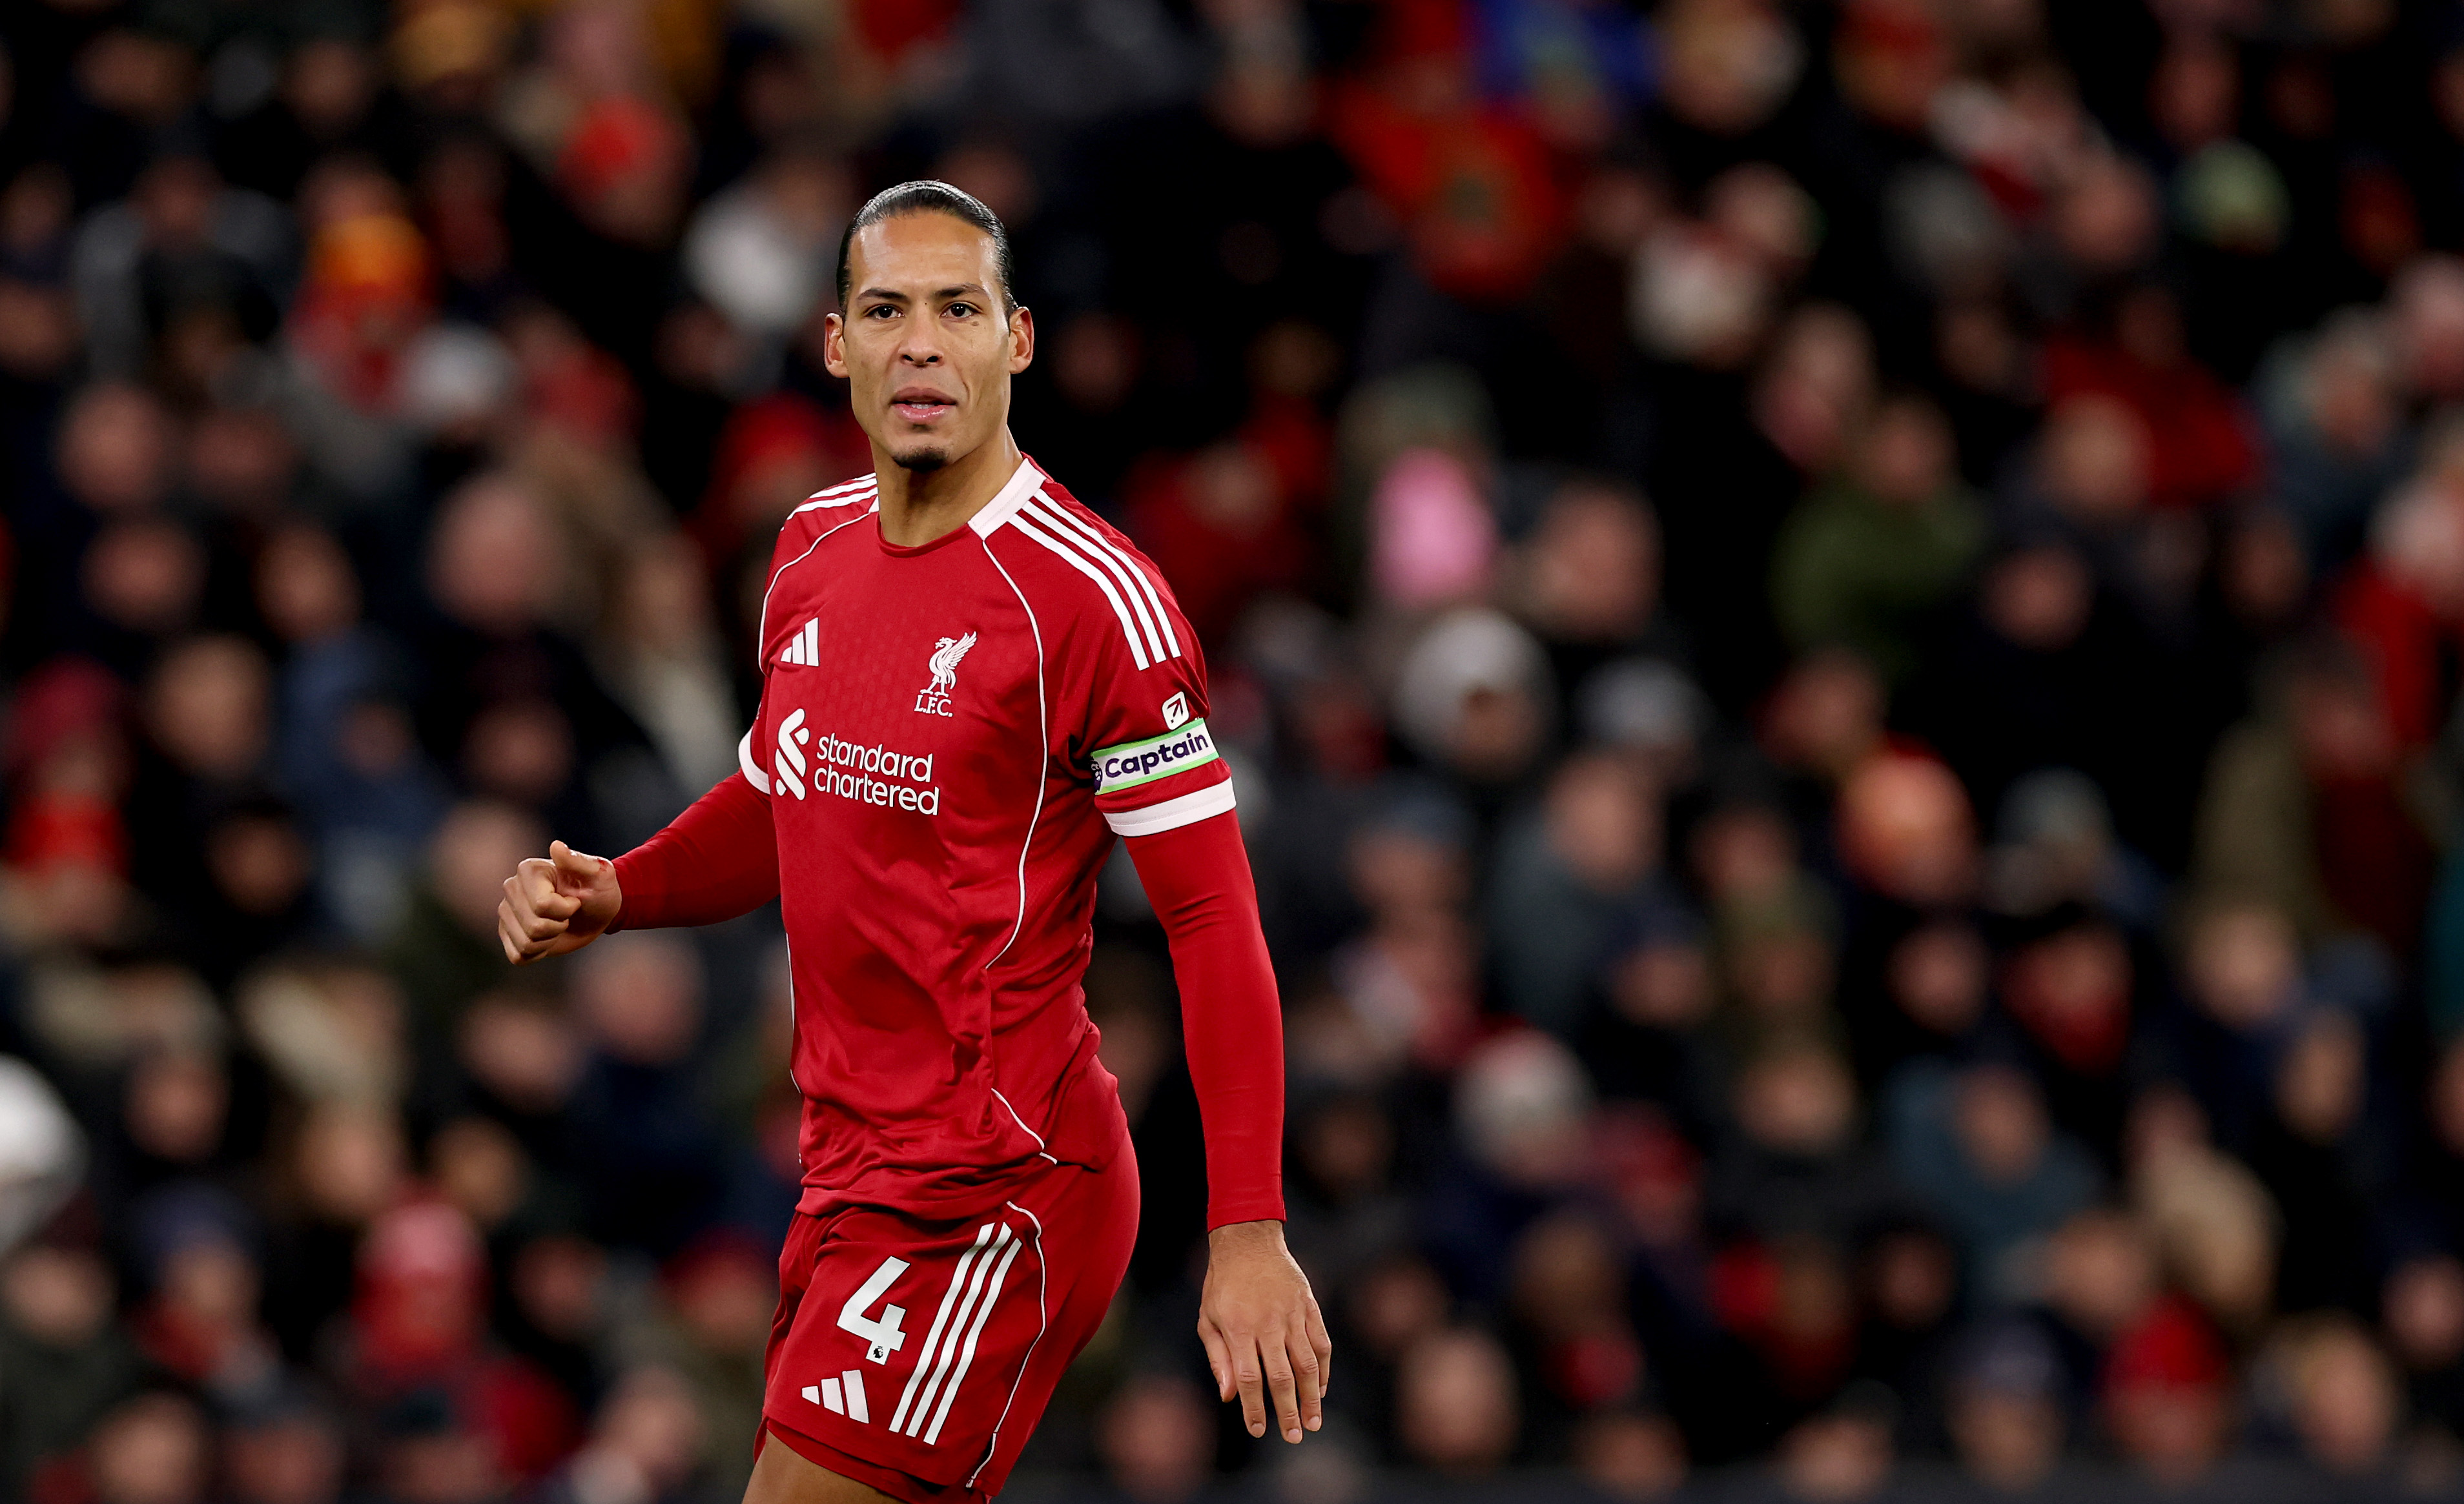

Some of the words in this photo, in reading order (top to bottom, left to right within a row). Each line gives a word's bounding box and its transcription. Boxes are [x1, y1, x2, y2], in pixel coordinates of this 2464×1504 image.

[816, 732, 933, 782] standard
[1105, 732, 1209, 778] Captain
[814, 764, 939, 816] chartered
[836, 1255, 910, 1366] 4
